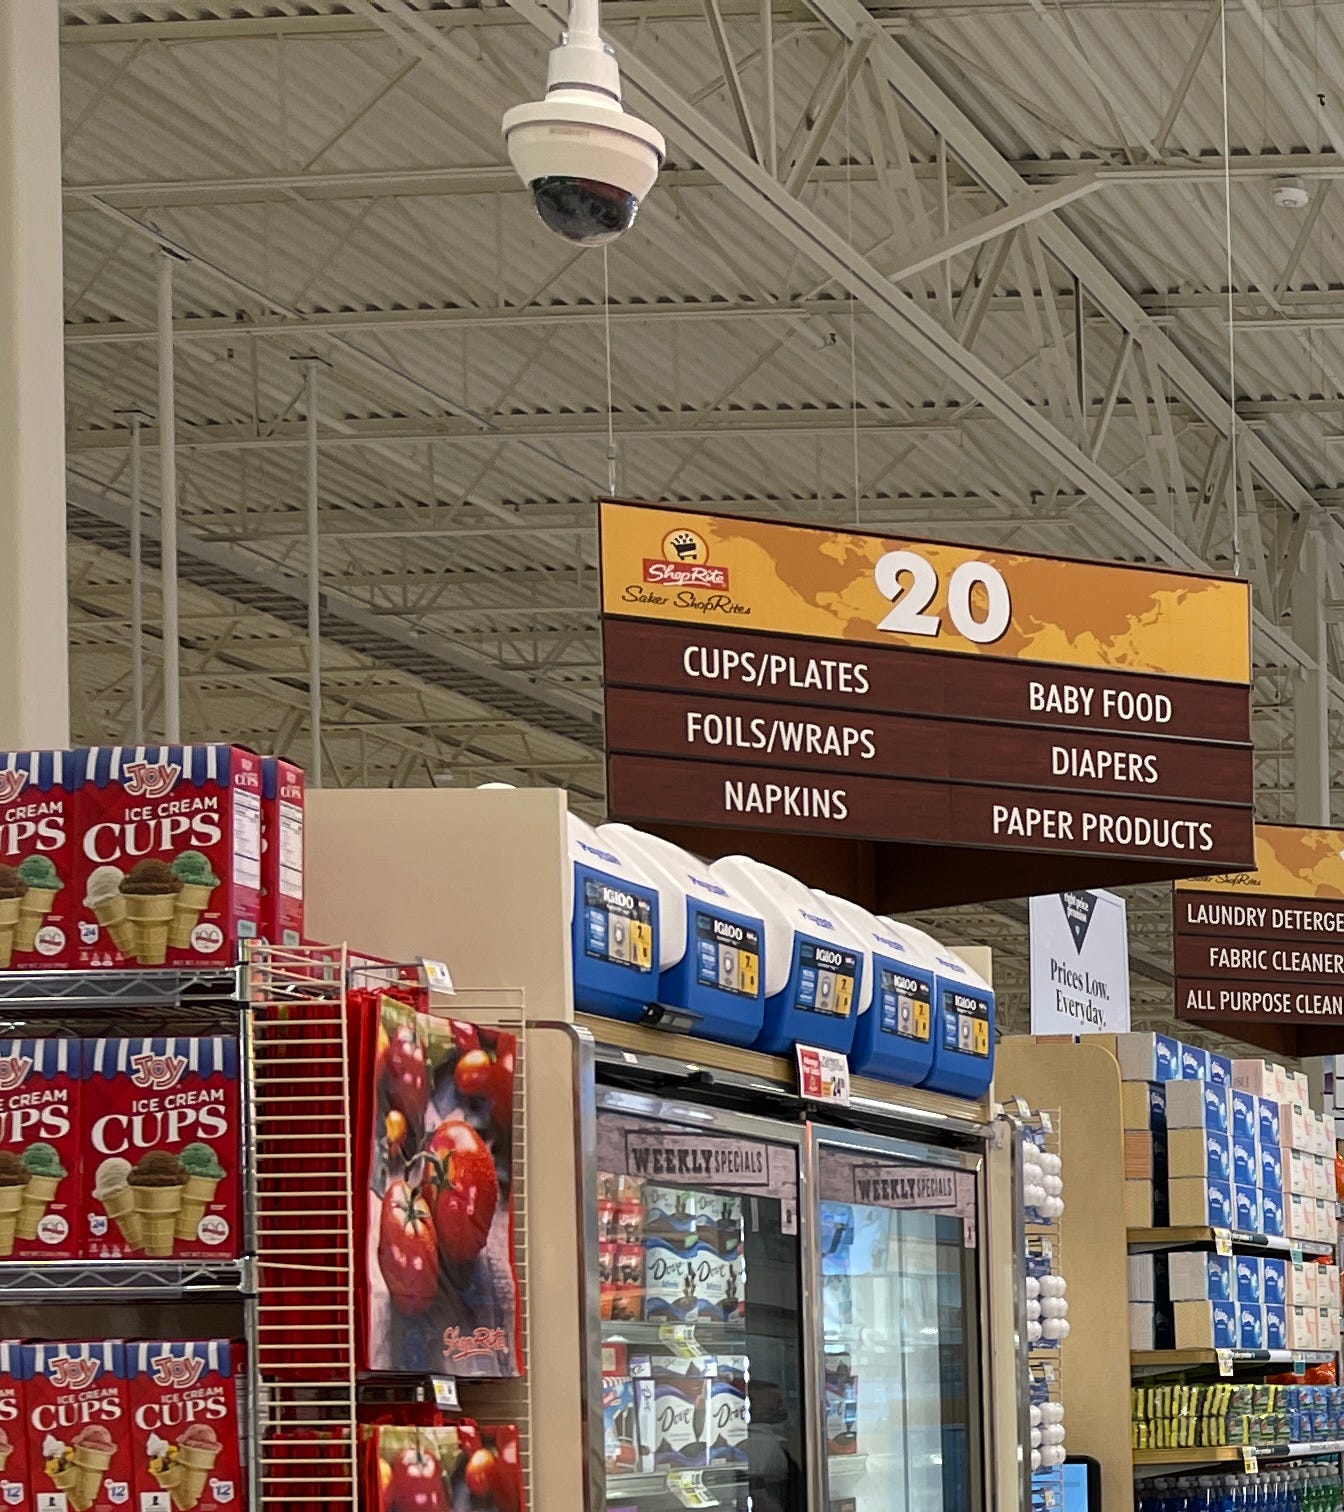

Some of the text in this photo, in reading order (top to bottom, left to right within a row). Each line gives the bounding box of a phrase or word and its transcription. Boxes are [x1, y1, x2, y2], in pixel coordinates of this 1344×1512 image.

[646, 562, 728, 588] ShopRite
[874, 550, 1011, 643] 20
[683, 645, 870, 695] CUPS/PLATES
[1028, 681, 1172, 723] BABY FOOD
[686, 712, 876, 759] FOILS/WRAPS
[1050, 746, 1158, 783] DIAPERS
[5, 802, 63, 822] CREAM
[124, 797, 218, 821] ICE CREAM
[724, 780, 848, 820] NAPKINS
[83, 812, 222, 863] CUPS
[992, 805, 1213, 851] PAPER PRODUCTS
[1186, 902, 1266, 930] LAUNDRY
[1209, 947, 1344, 976] FABRIC CLEANER
[1050, 958, 1110, 1001] Prices Low.
[1056, 989, 1107, 1029] Everyday.
[1186, 989, 1215, 1011] ALL
[1220, 991, 1292, 1014] PURPOSE
[9, 1089, 68, 1108] CREAM
[132, 1089, 224, 1113] ICE CREAM
[91, 1104, 228, 1154] CUPS
[632, 1147, 764, 1175] WEEKLY SPECIALS
[859, 1175, 953, 1200] WEEKLY SPECIALS
[78, 1387, 118, 1401] CREAM
[182, 1386, 224, 1400] CREAM
[31, 1398, 122, 1431] CUPS
[135, 1396, 228, 1430] CUPS
